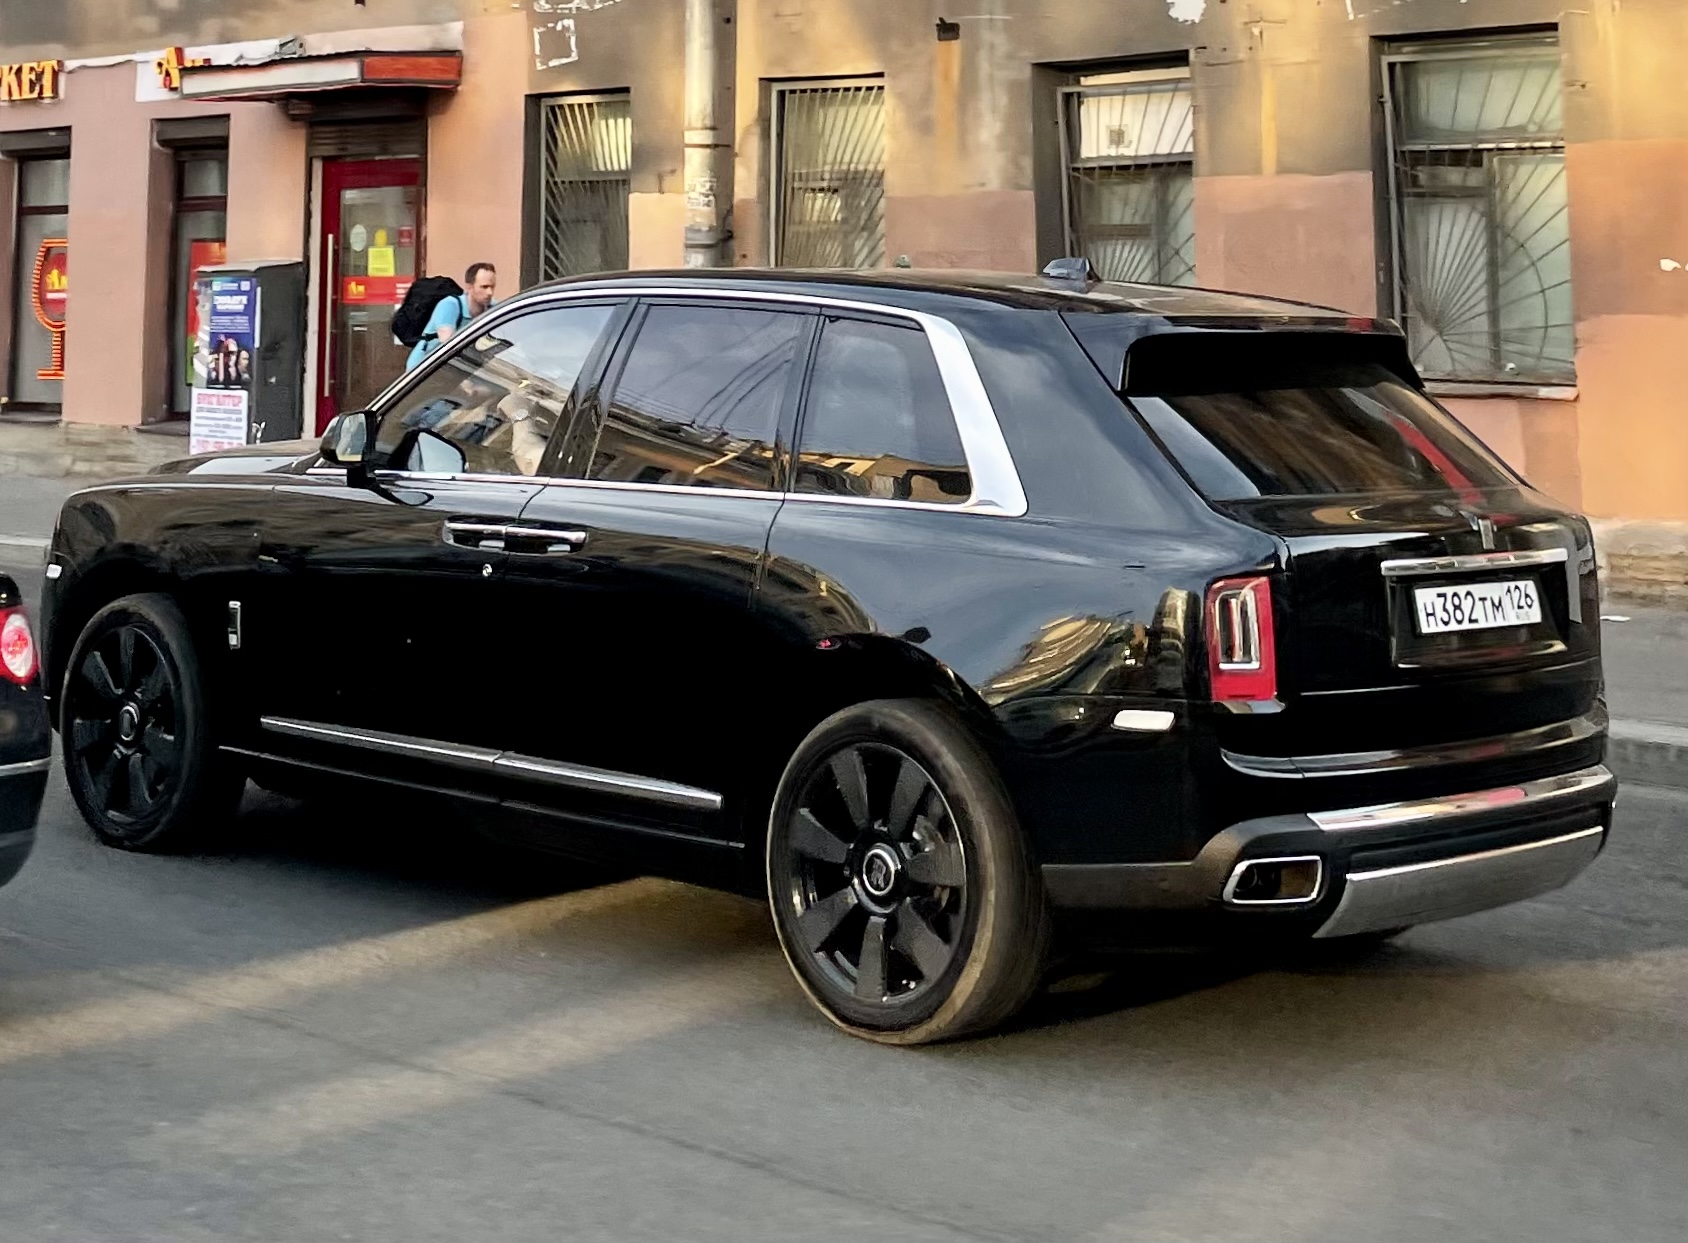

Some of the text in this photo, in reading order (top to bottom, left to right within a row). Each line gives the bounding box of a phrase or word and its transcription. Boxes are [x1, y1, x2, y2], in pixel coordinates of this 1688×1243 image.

[0, 60, 60, 101] КЕТ
[1423, 584, 1534, 628] Н382ТМ 126
